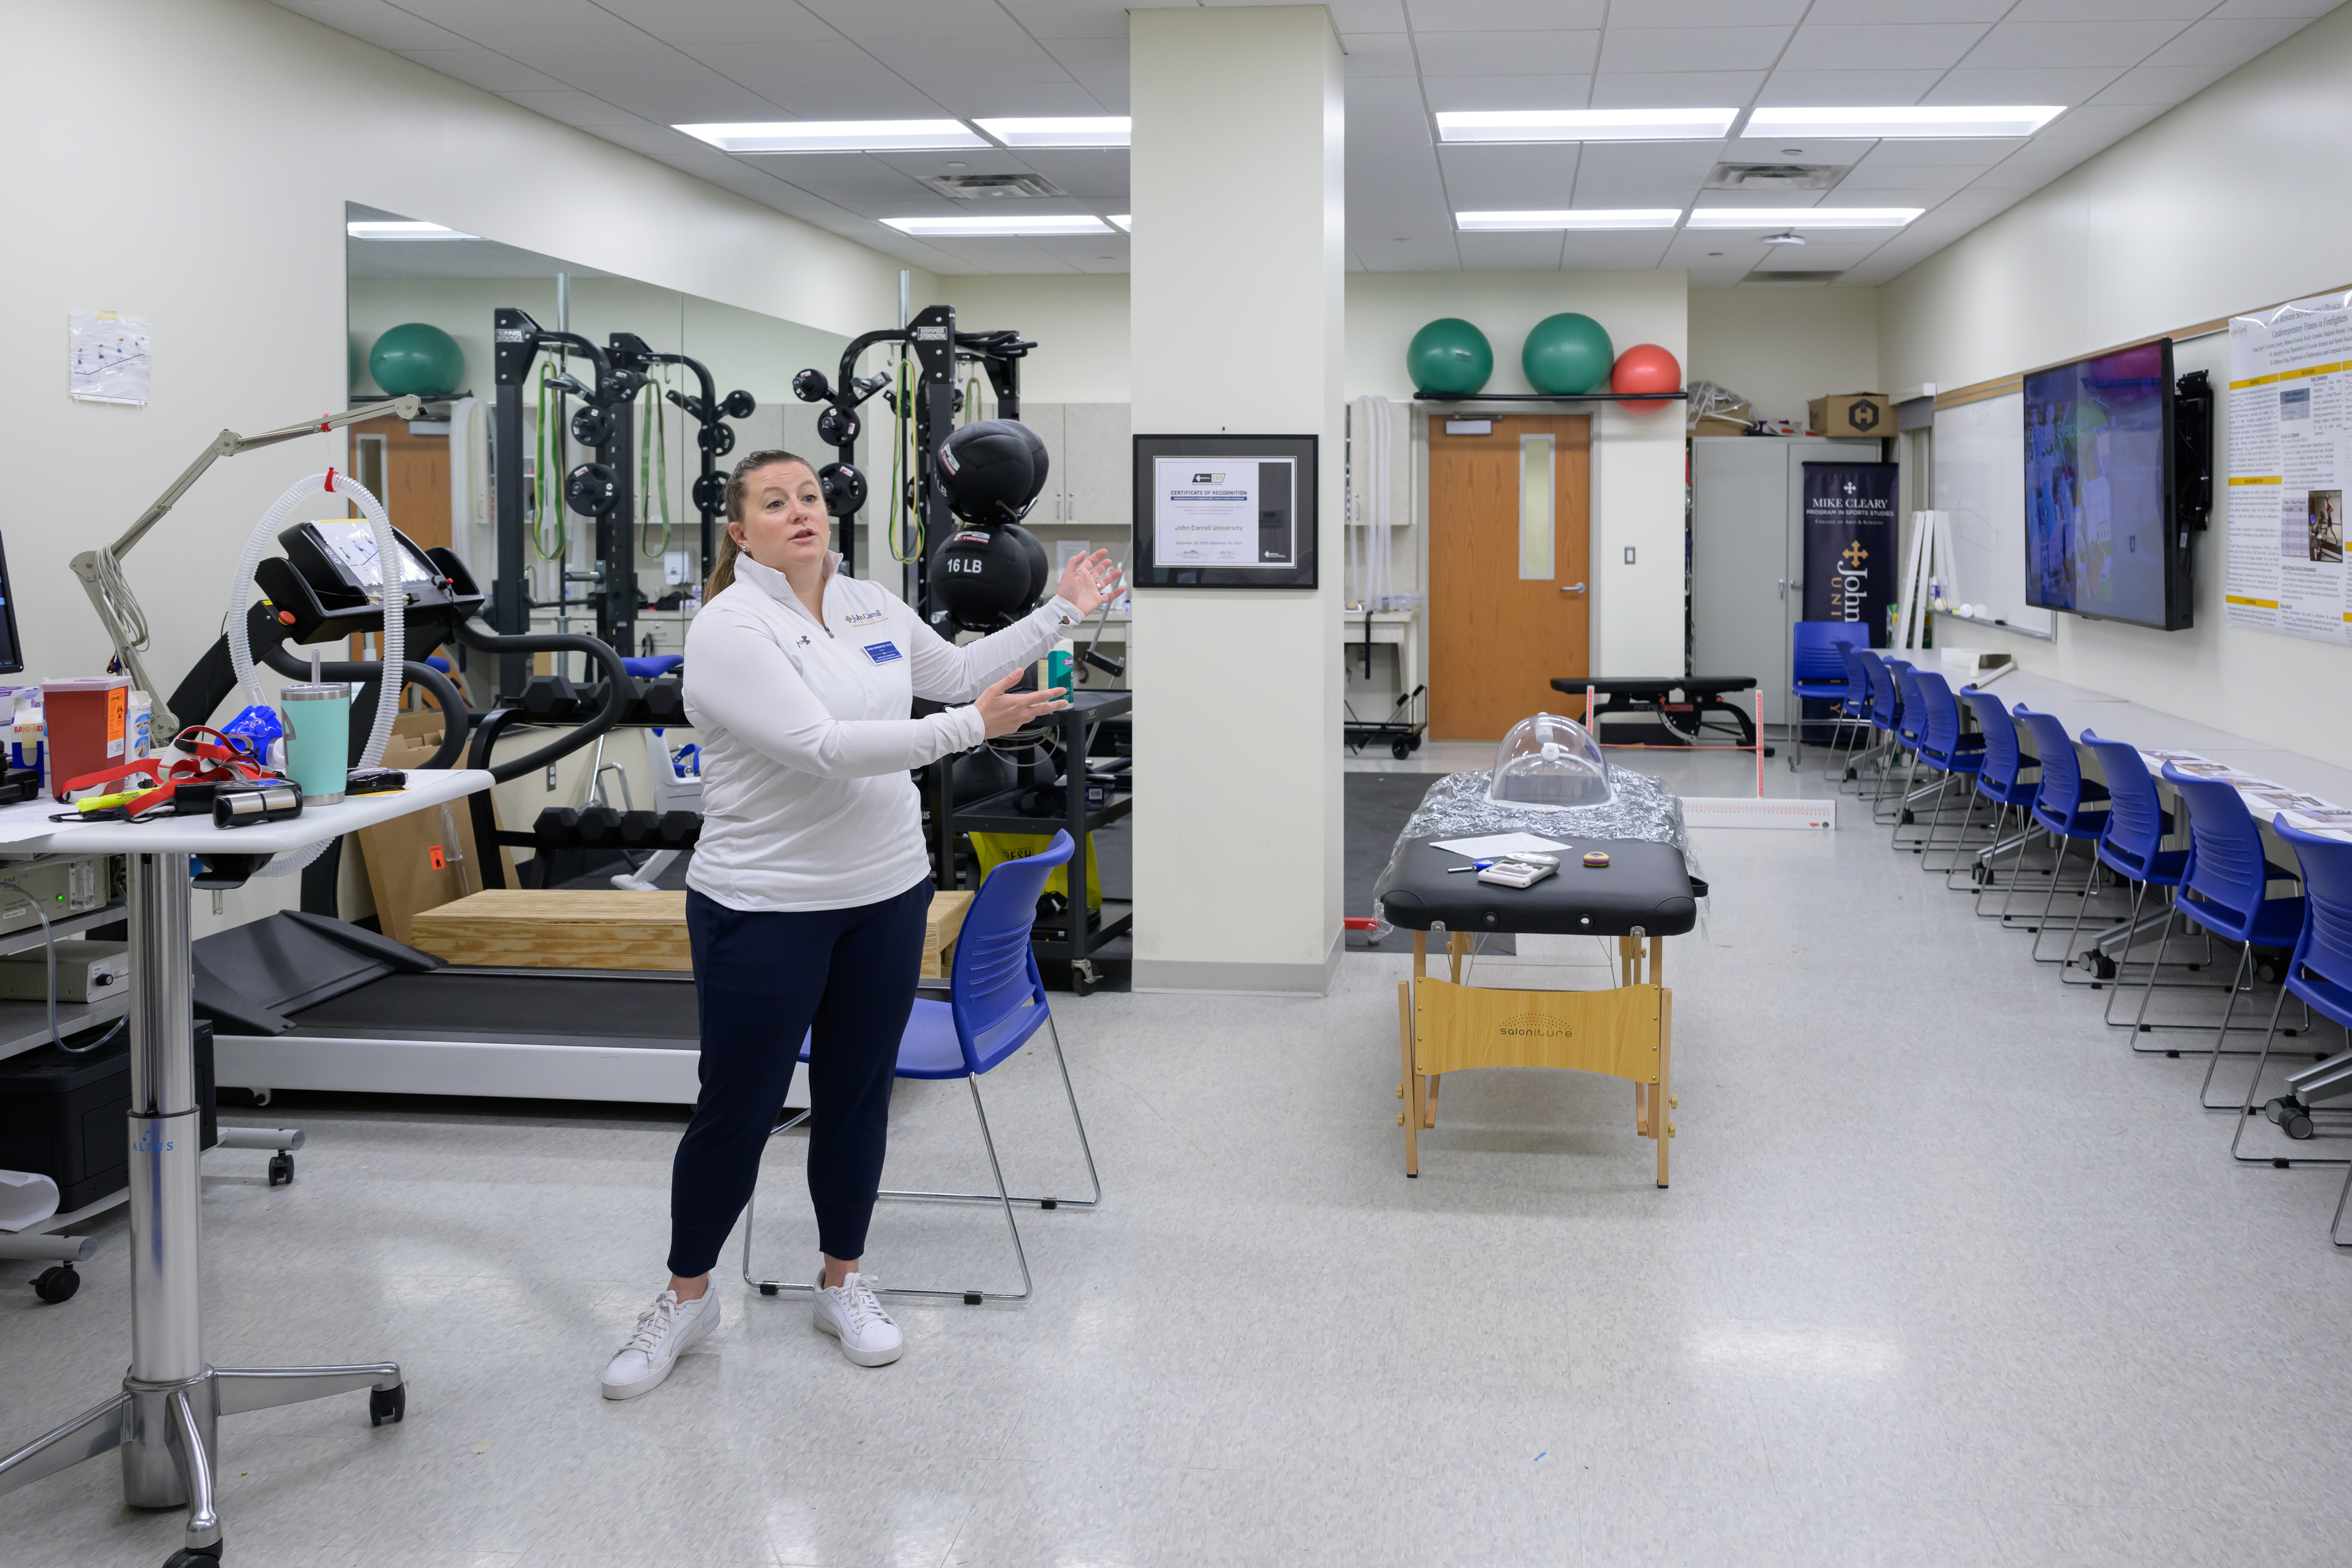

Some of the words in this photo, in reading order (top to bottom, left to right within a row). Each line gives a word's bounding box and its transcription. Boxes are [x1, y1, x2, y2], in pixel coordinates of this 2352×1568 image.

[2304, 321, 2318, 330] Fitness
[2323, 315, 2348, 326] Firefighters
[829, 408, 837, 416] 5
[1812, 498, 1843, 508] MIKE
[1845, 498, 1888, 509] CLEARY
[947, 558, 961, 573] 16
[963, 558, 982, 573] LB
[1837, 560, 1868, 623] John
[851, 614, 865, 623] John
[863, 610, 882, 620] Carroll
[1500, 1028, 1572, 1038] saloniture
[132, 1141, 174, 1152] ALTUS
